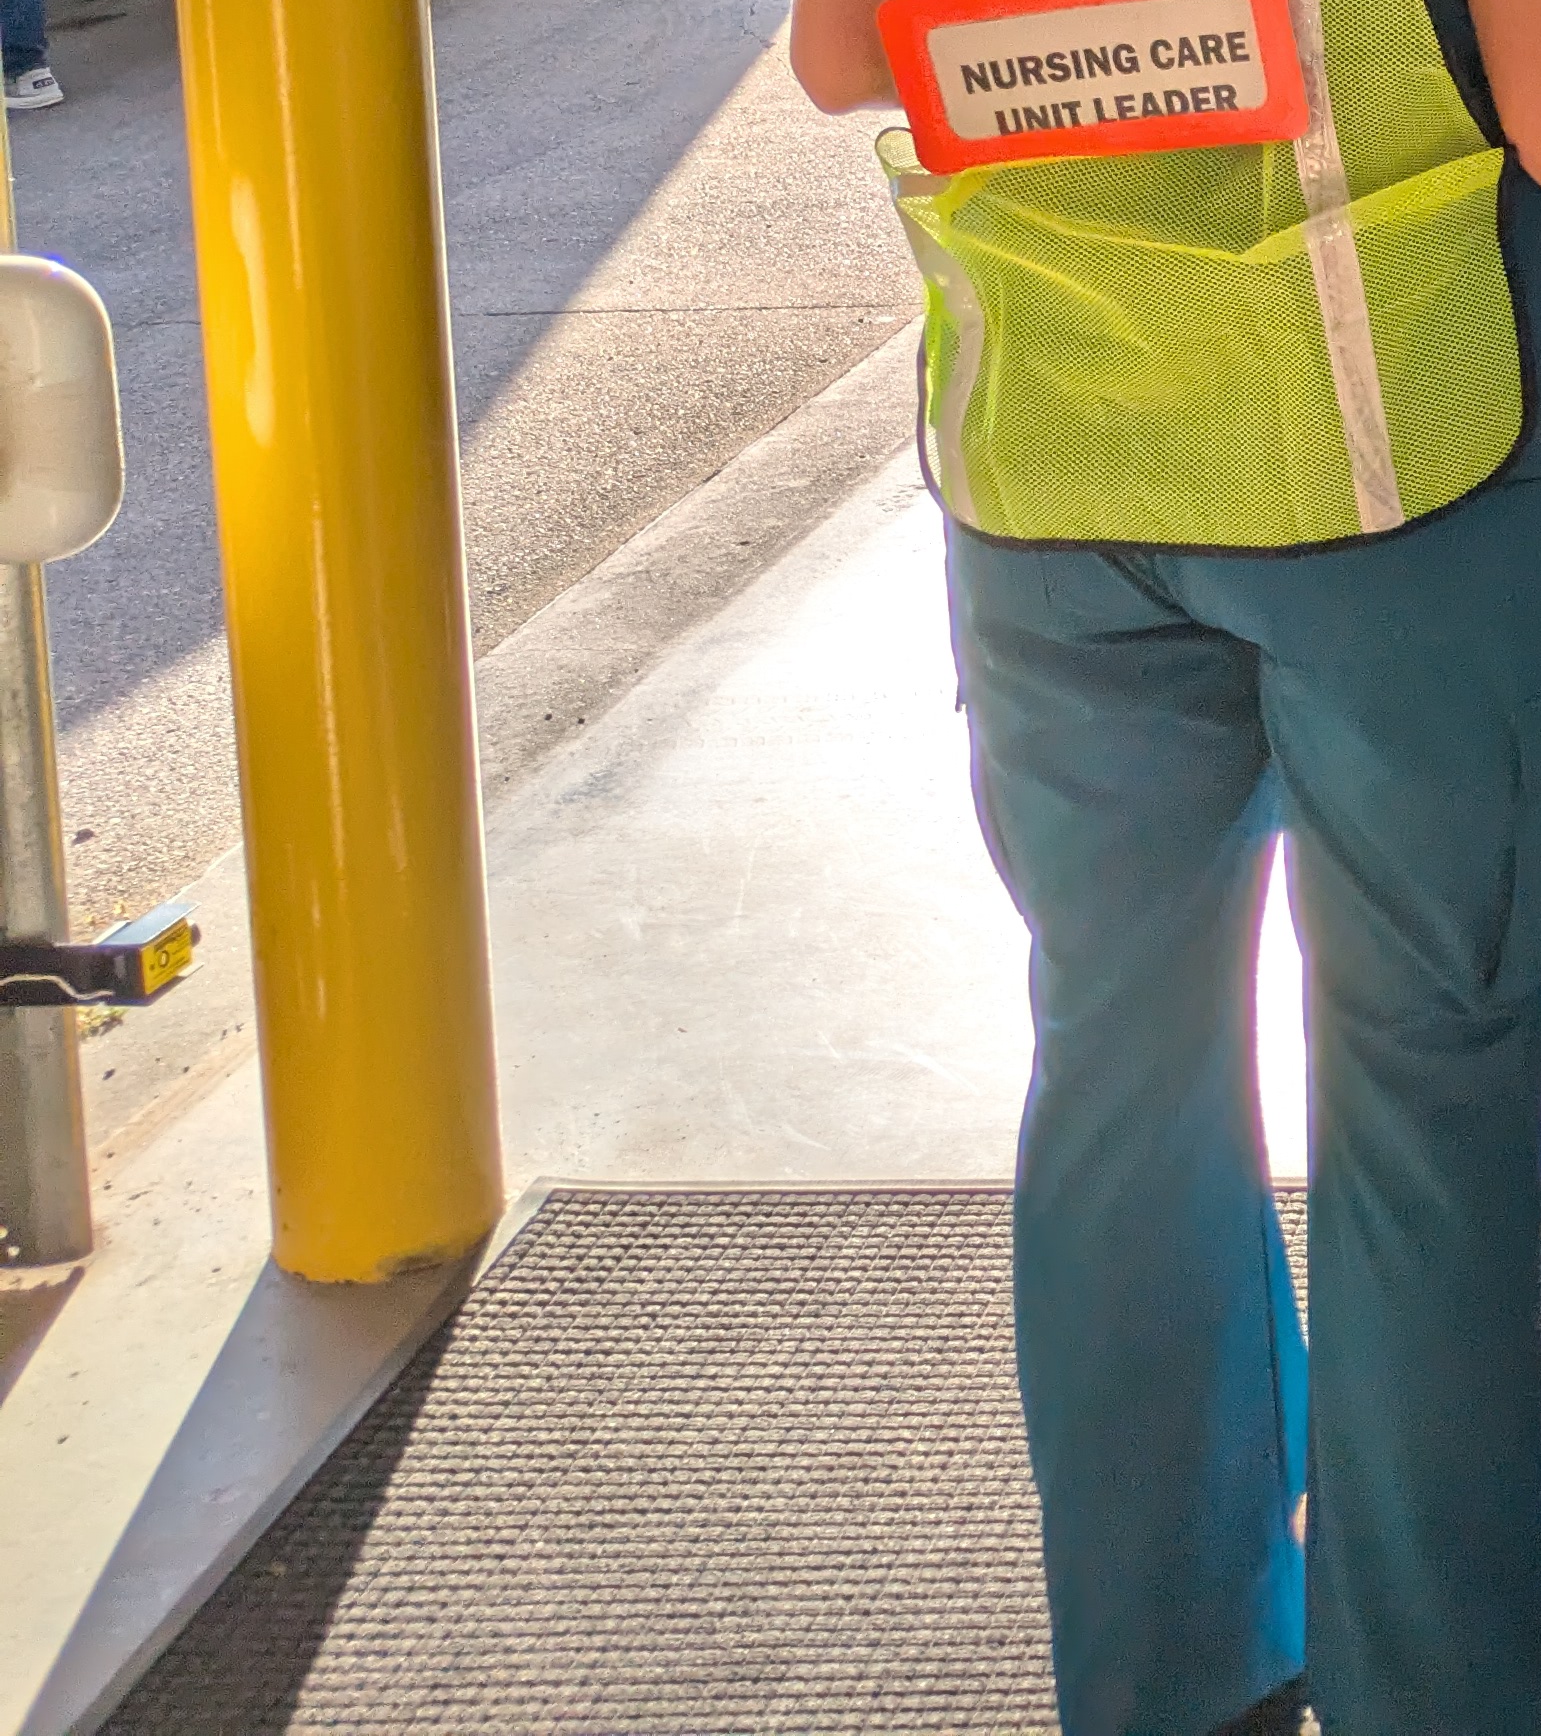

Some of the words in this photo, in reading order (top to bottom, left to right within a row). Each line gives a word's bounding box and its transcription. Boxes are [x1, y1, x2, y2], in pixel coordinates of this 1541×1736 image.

[960, 43, 1141, 95] NURSING
[1149, 31, 1251, 71] CARE
[994, 100, 1085, 136] UNIT
[1093, 83, 1240, 124] LEADER
